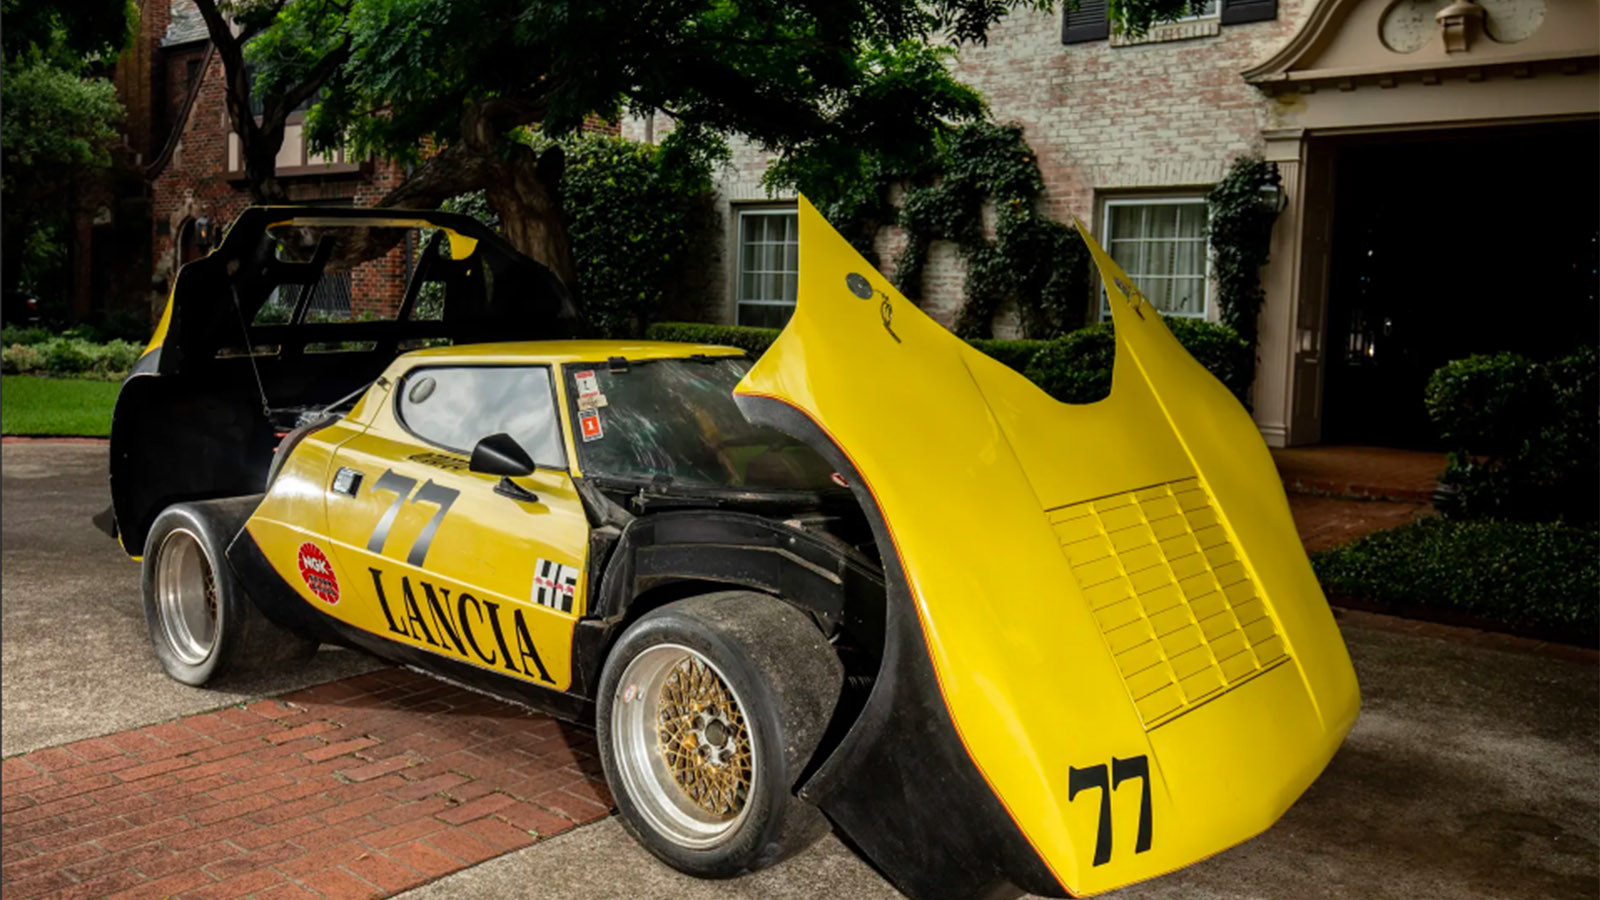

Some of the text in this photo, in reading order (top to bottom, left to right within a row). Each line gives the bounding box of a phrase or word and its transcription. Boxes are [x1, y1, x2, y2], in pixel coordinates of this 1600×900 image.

[302, 554, 330, 575] NGK
[367, 468, 460, 567] 77
[368, 567, 556, 685] LANCIA
[1068, 754, 1153, 867] 77
